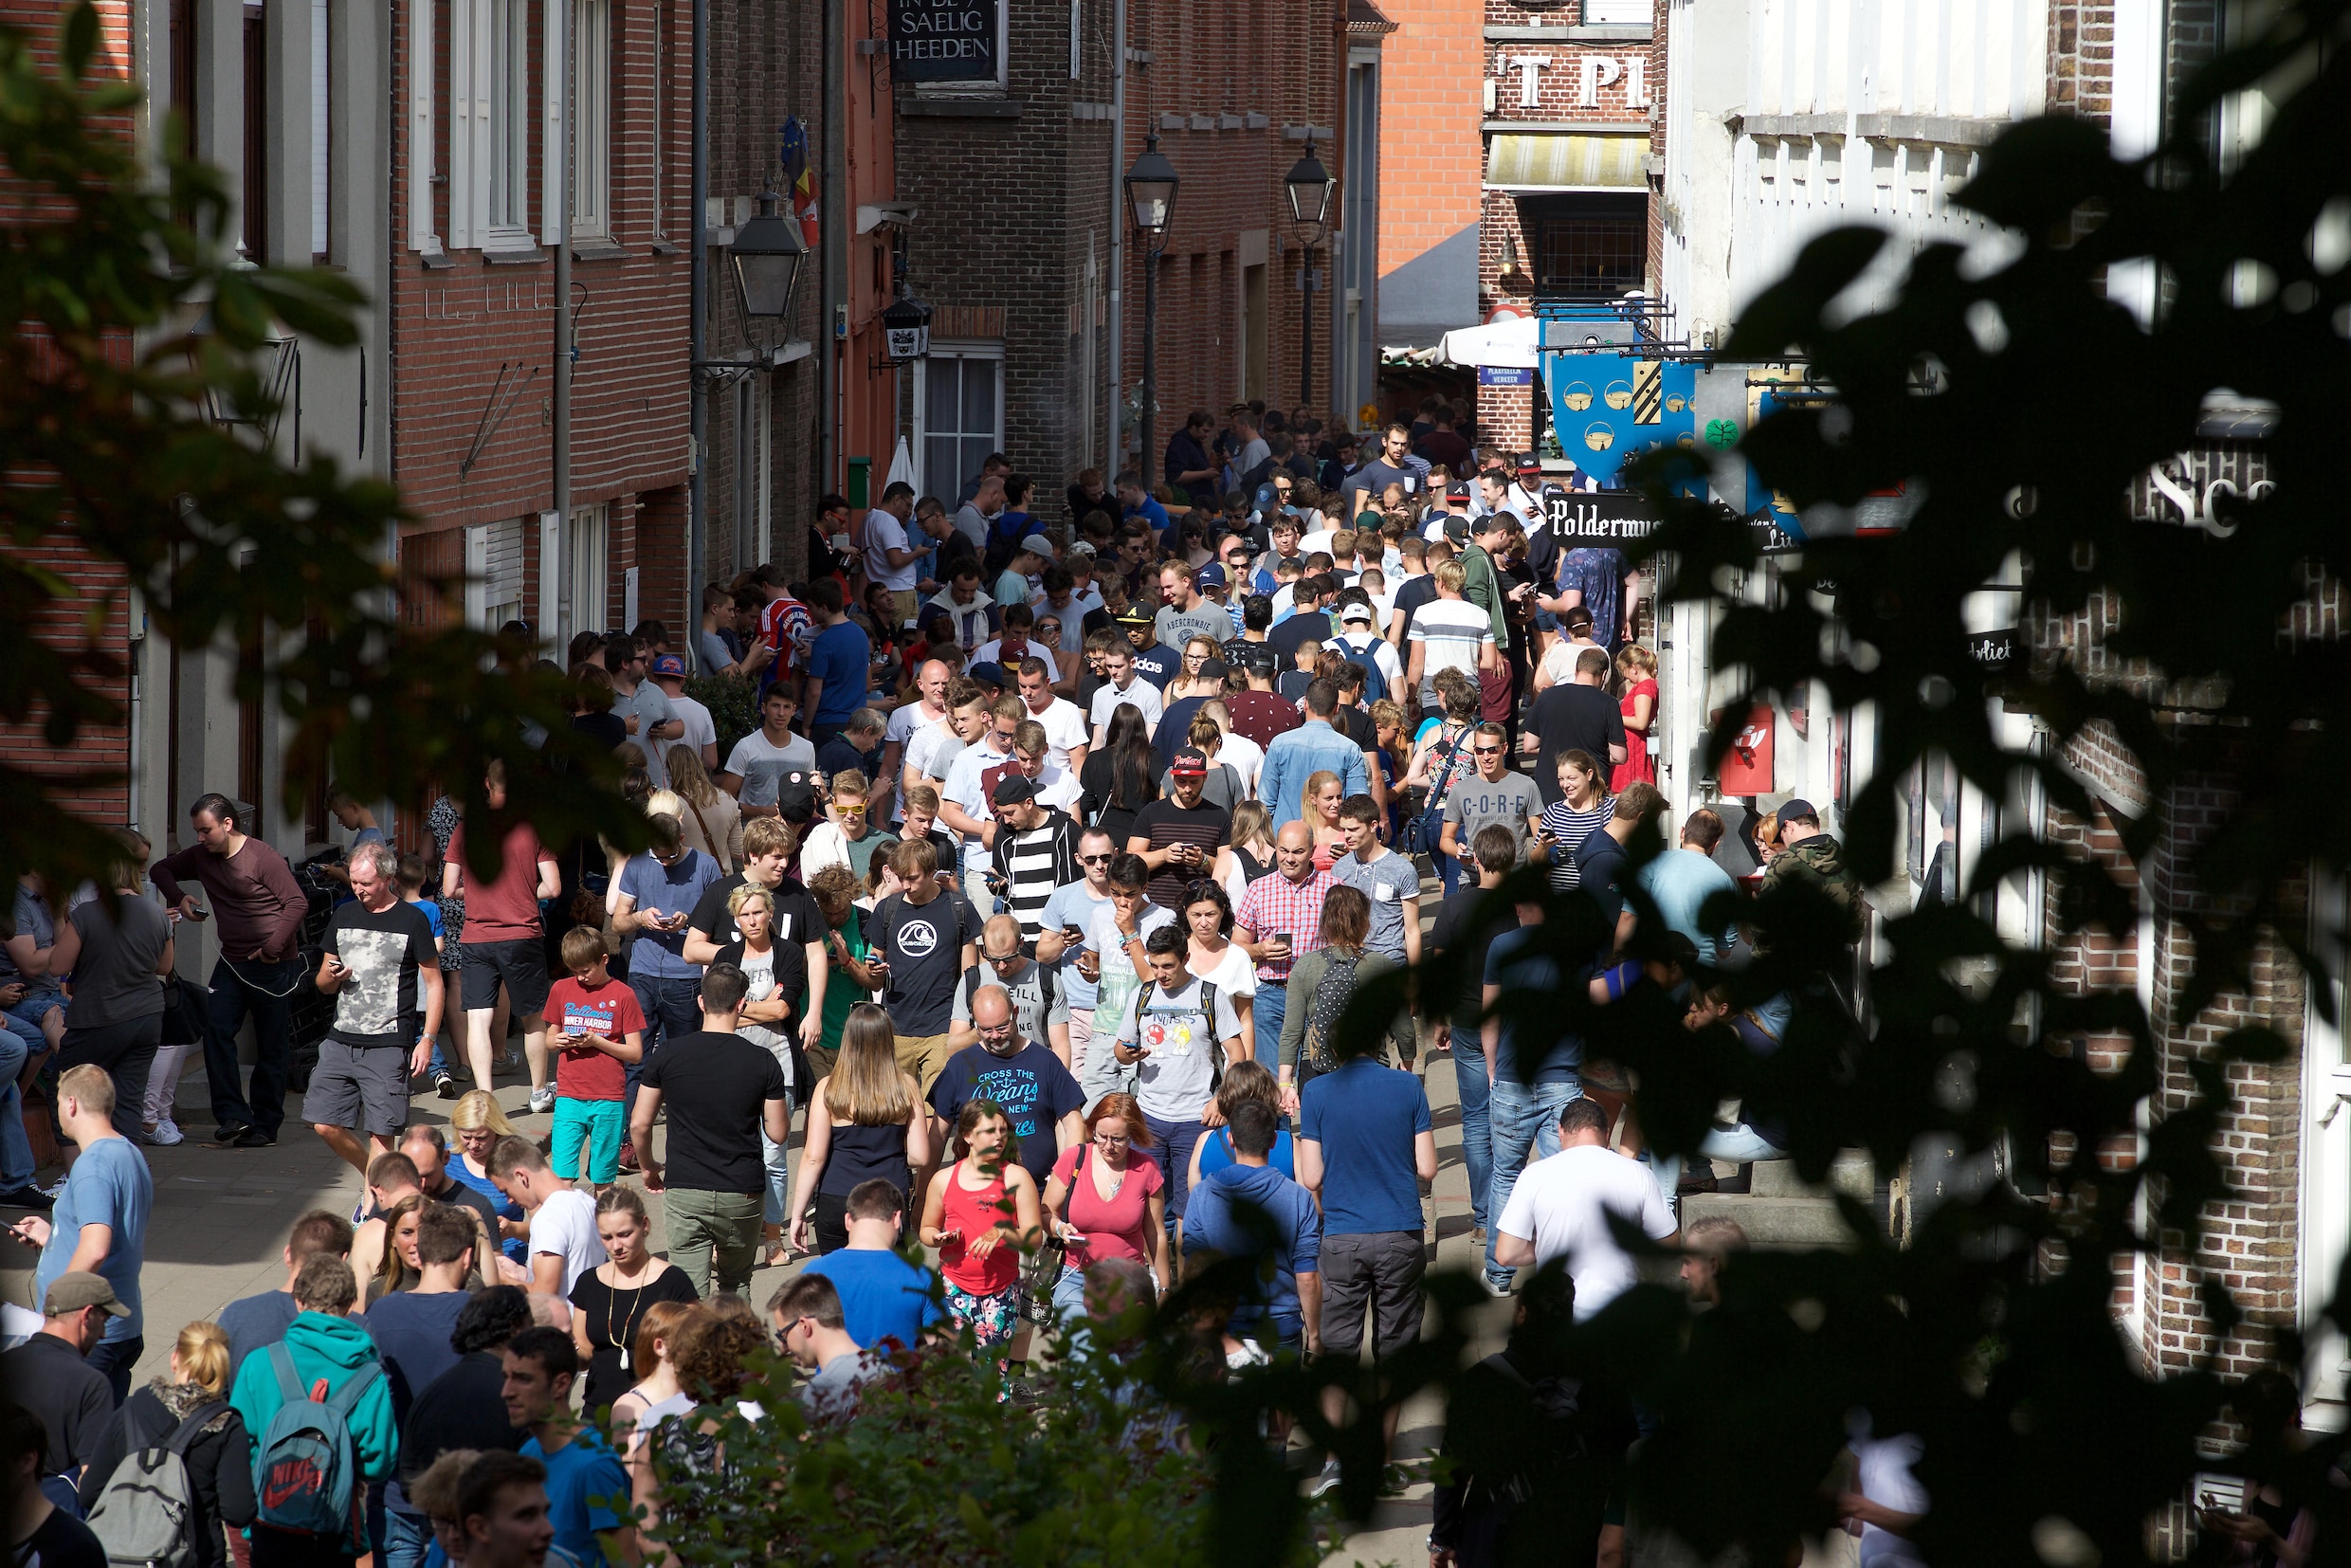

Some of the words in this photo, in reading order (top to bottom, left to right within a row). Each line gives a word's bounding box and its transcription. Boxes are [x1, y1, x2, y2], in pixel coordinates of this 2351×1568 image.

[901, 10, 984, 34] SAELIG
[895, 37, 991, 60] HEEDEN
[1493, 375, 1519, 384] VERKEER
[1167, 618, 1212, 631] ABERCROMBIE
[564, 1002, 613, 1021] Baltimore
[583, 1017, 612, 1030] HARBOR
[978, 1069, 1012, 1083] CROSS
[1015, 1068, 1035, 1081] THE
